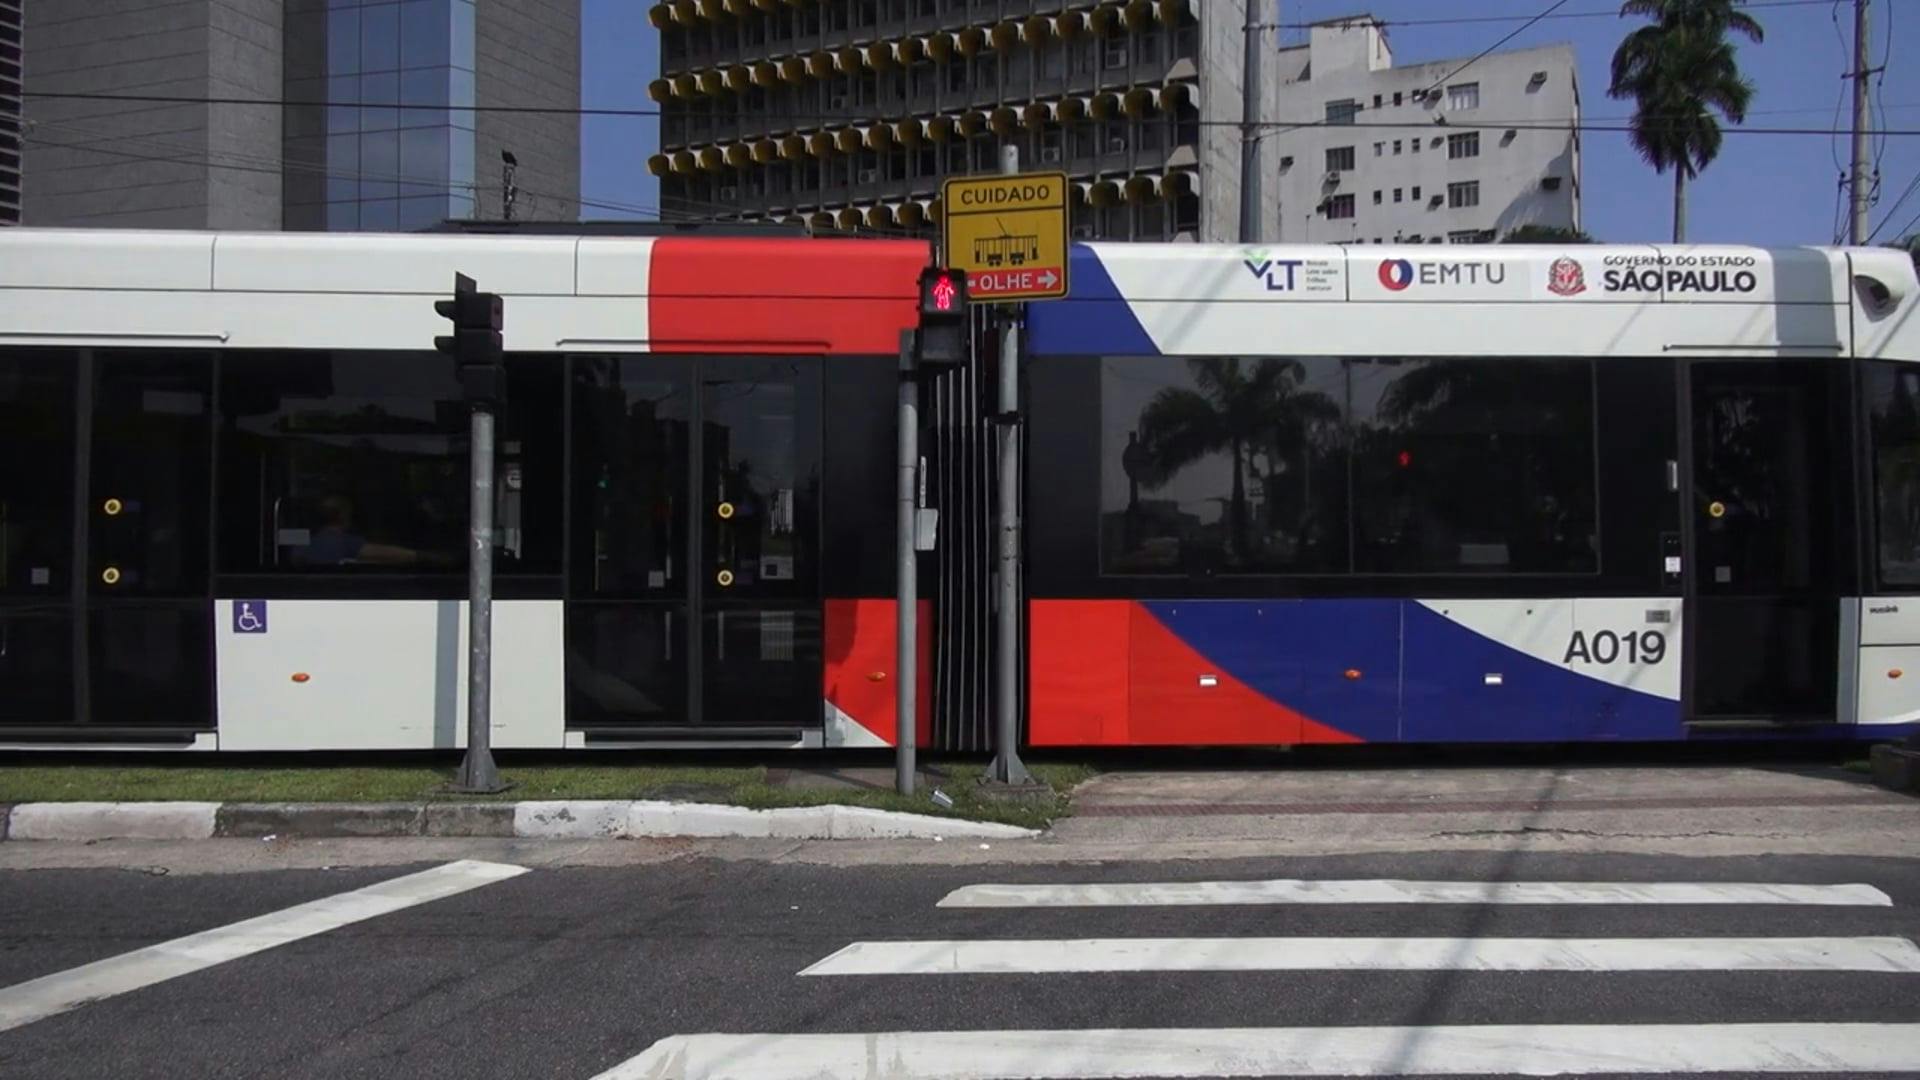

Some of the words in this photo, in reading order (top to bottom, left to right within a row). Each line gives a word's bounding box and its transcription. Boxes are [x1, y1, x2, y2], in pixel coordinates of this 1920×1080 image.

[961, 184, 1050, 205] CUIDADO
[1603, 255, 1672, 267] GOVERNO
[1675, 255, 1697, 267] DO
[1701, 255, 1756, 267] ESTADO
[979, 272, 1033, 291] OLHE
[1244, 260, 1303, 291] VLT
[1419, 262, 1505, 285] EMTU
[1603, 265, 1663, 293] SÃO
[1666, 270, 1757, 293] PAULO
[1563, 630, 1666, 665] A019
